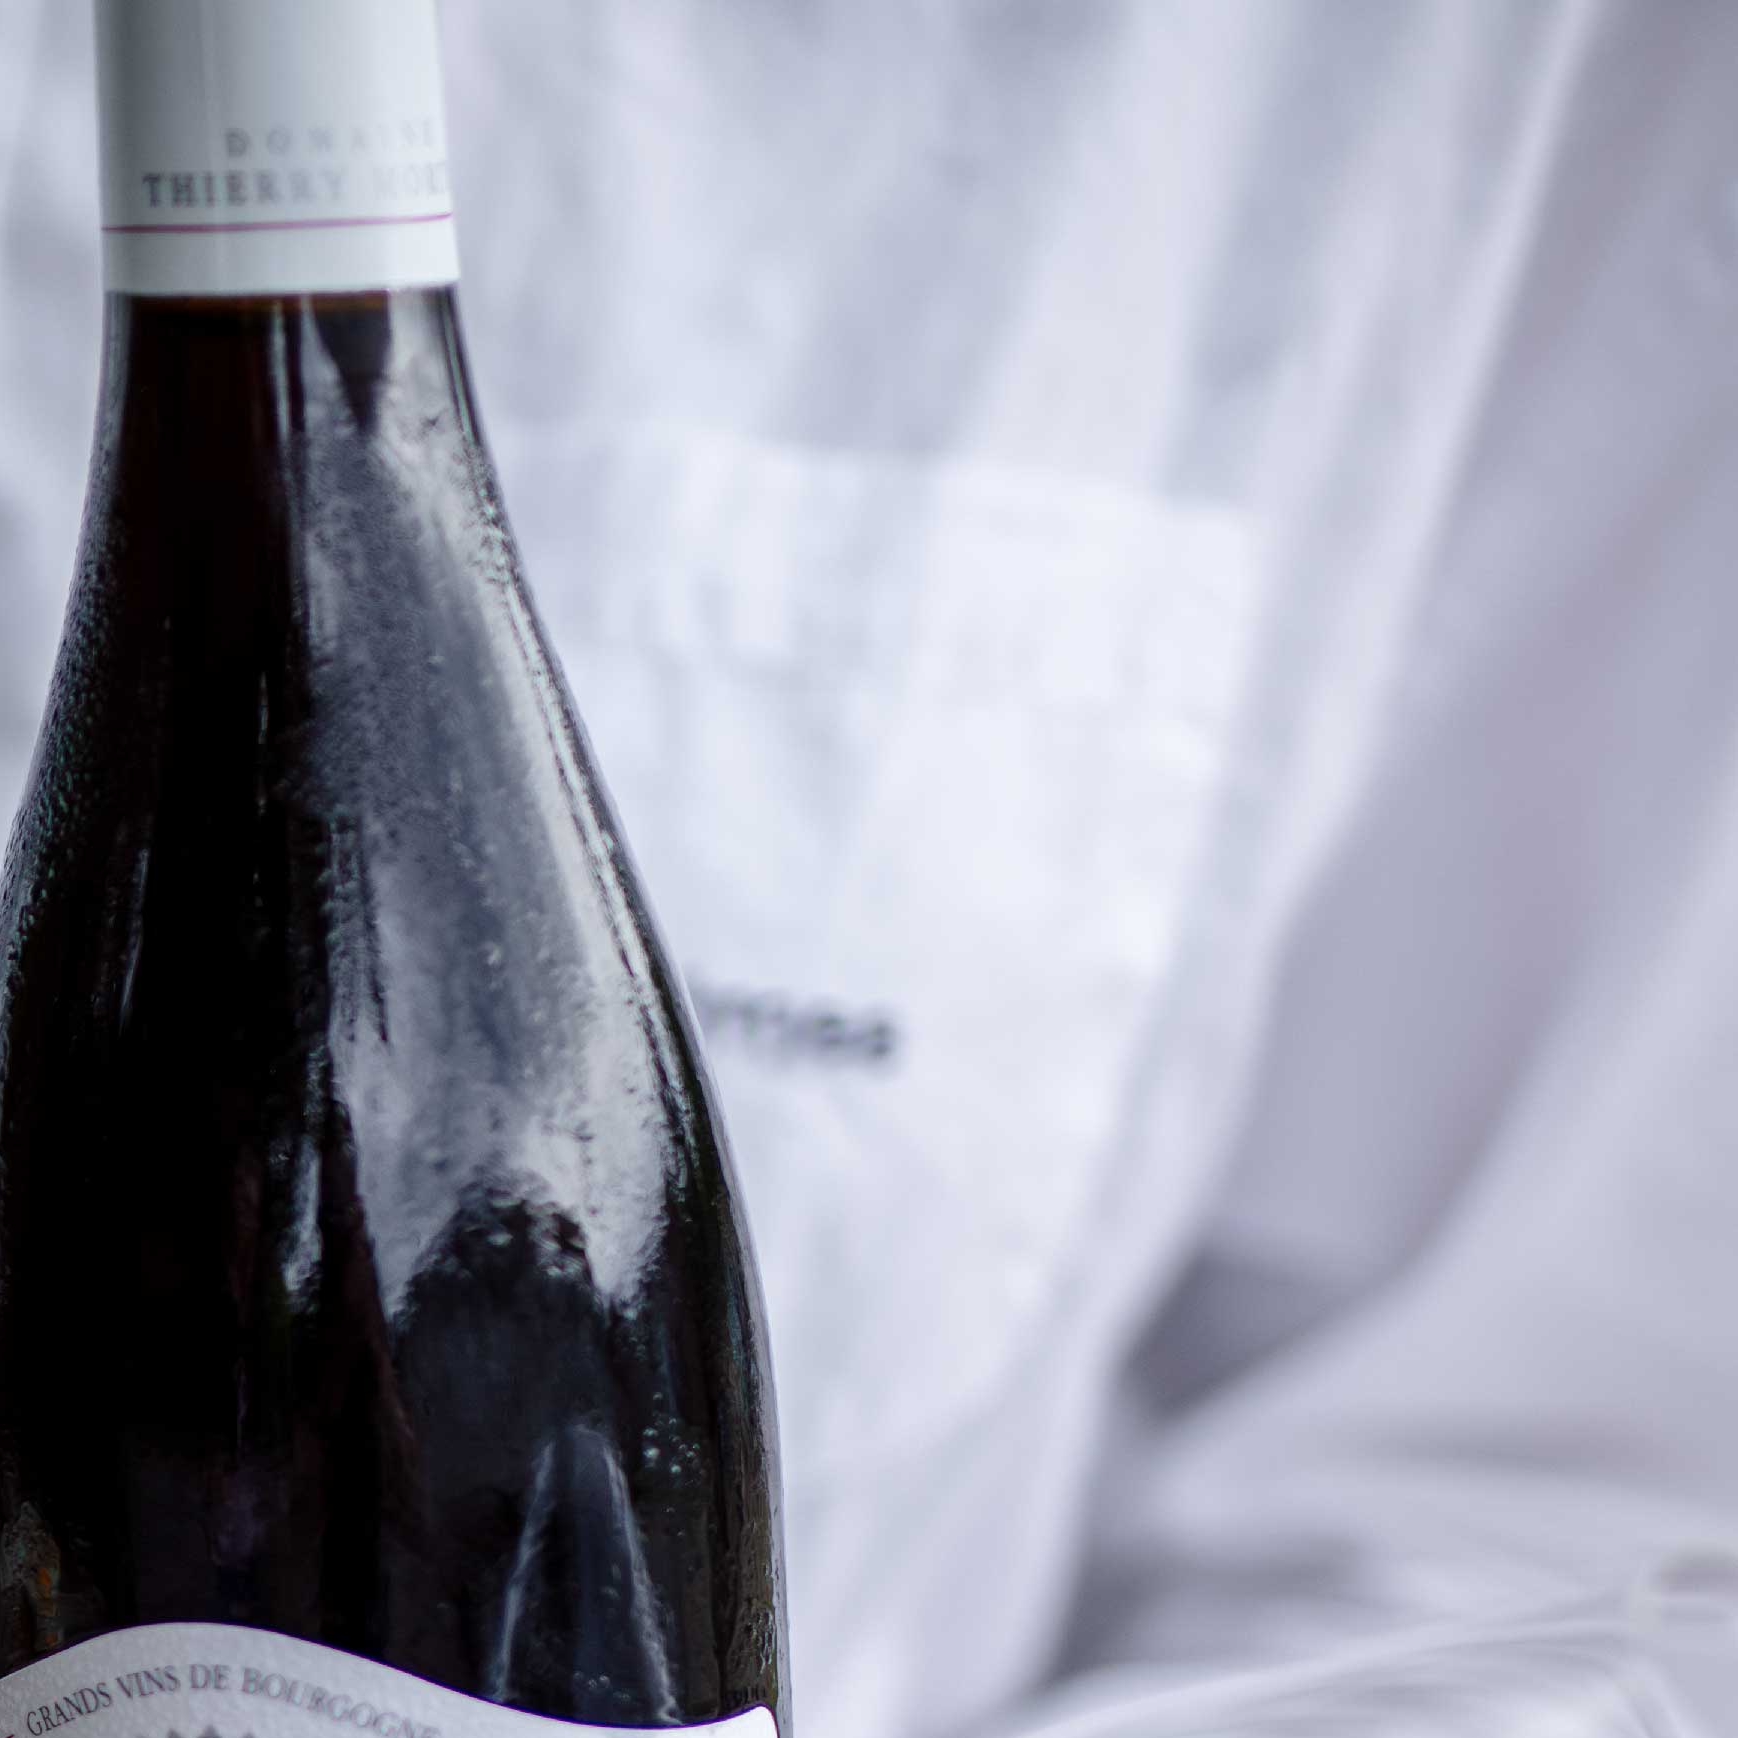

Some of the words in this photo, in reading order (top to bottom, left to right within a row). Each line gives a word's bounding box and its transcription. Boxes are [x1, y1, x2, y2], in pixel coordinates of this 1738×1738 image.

[142, 167, 346, 208] THIERRY
[26, 1681, 113, 1737] GRANDS
[115, 1664, 181, 1699] VINS
[190, 1663, 232, 1691] DE
